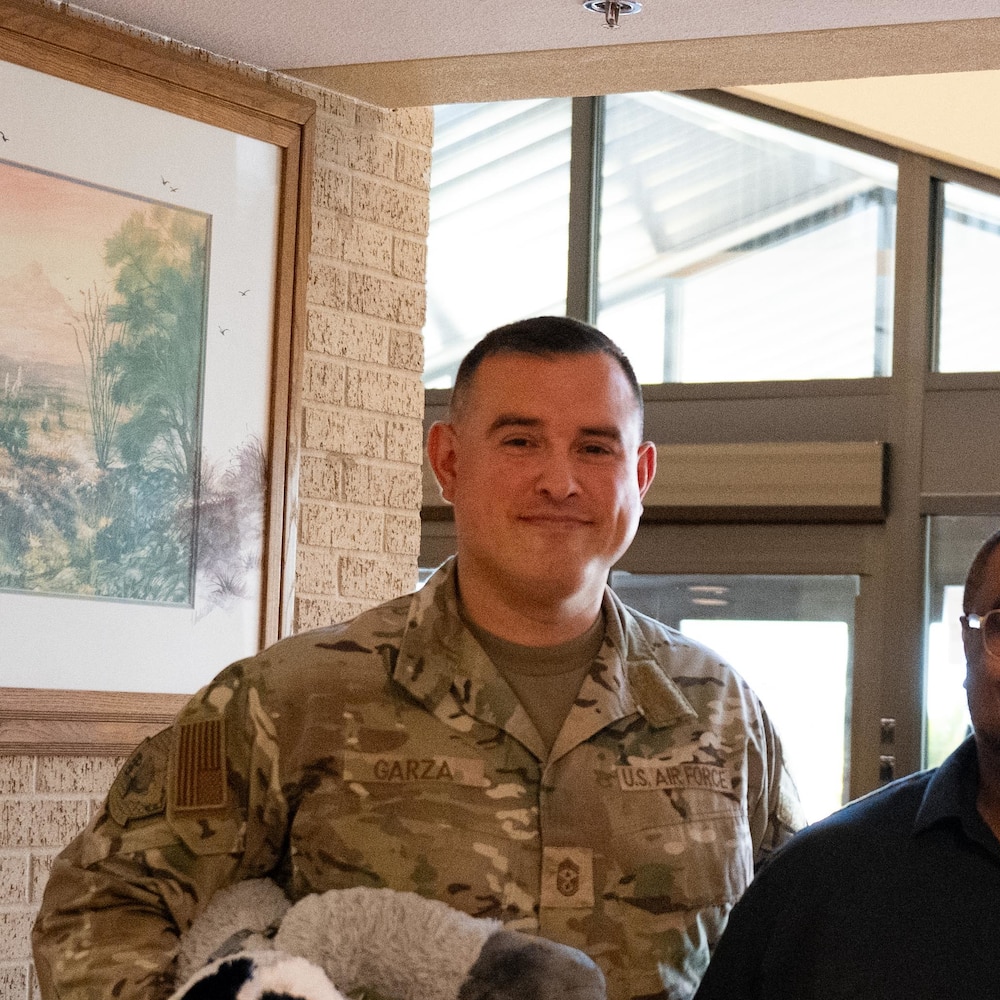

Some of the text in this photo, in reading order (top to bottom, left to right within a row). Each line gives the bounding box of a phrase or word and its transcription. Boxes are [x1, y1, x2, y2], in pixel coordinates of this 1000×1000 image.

[374, 759, 454, 781] GARZA
[622, 765, 729, 789] U.S. AIR FORCE
